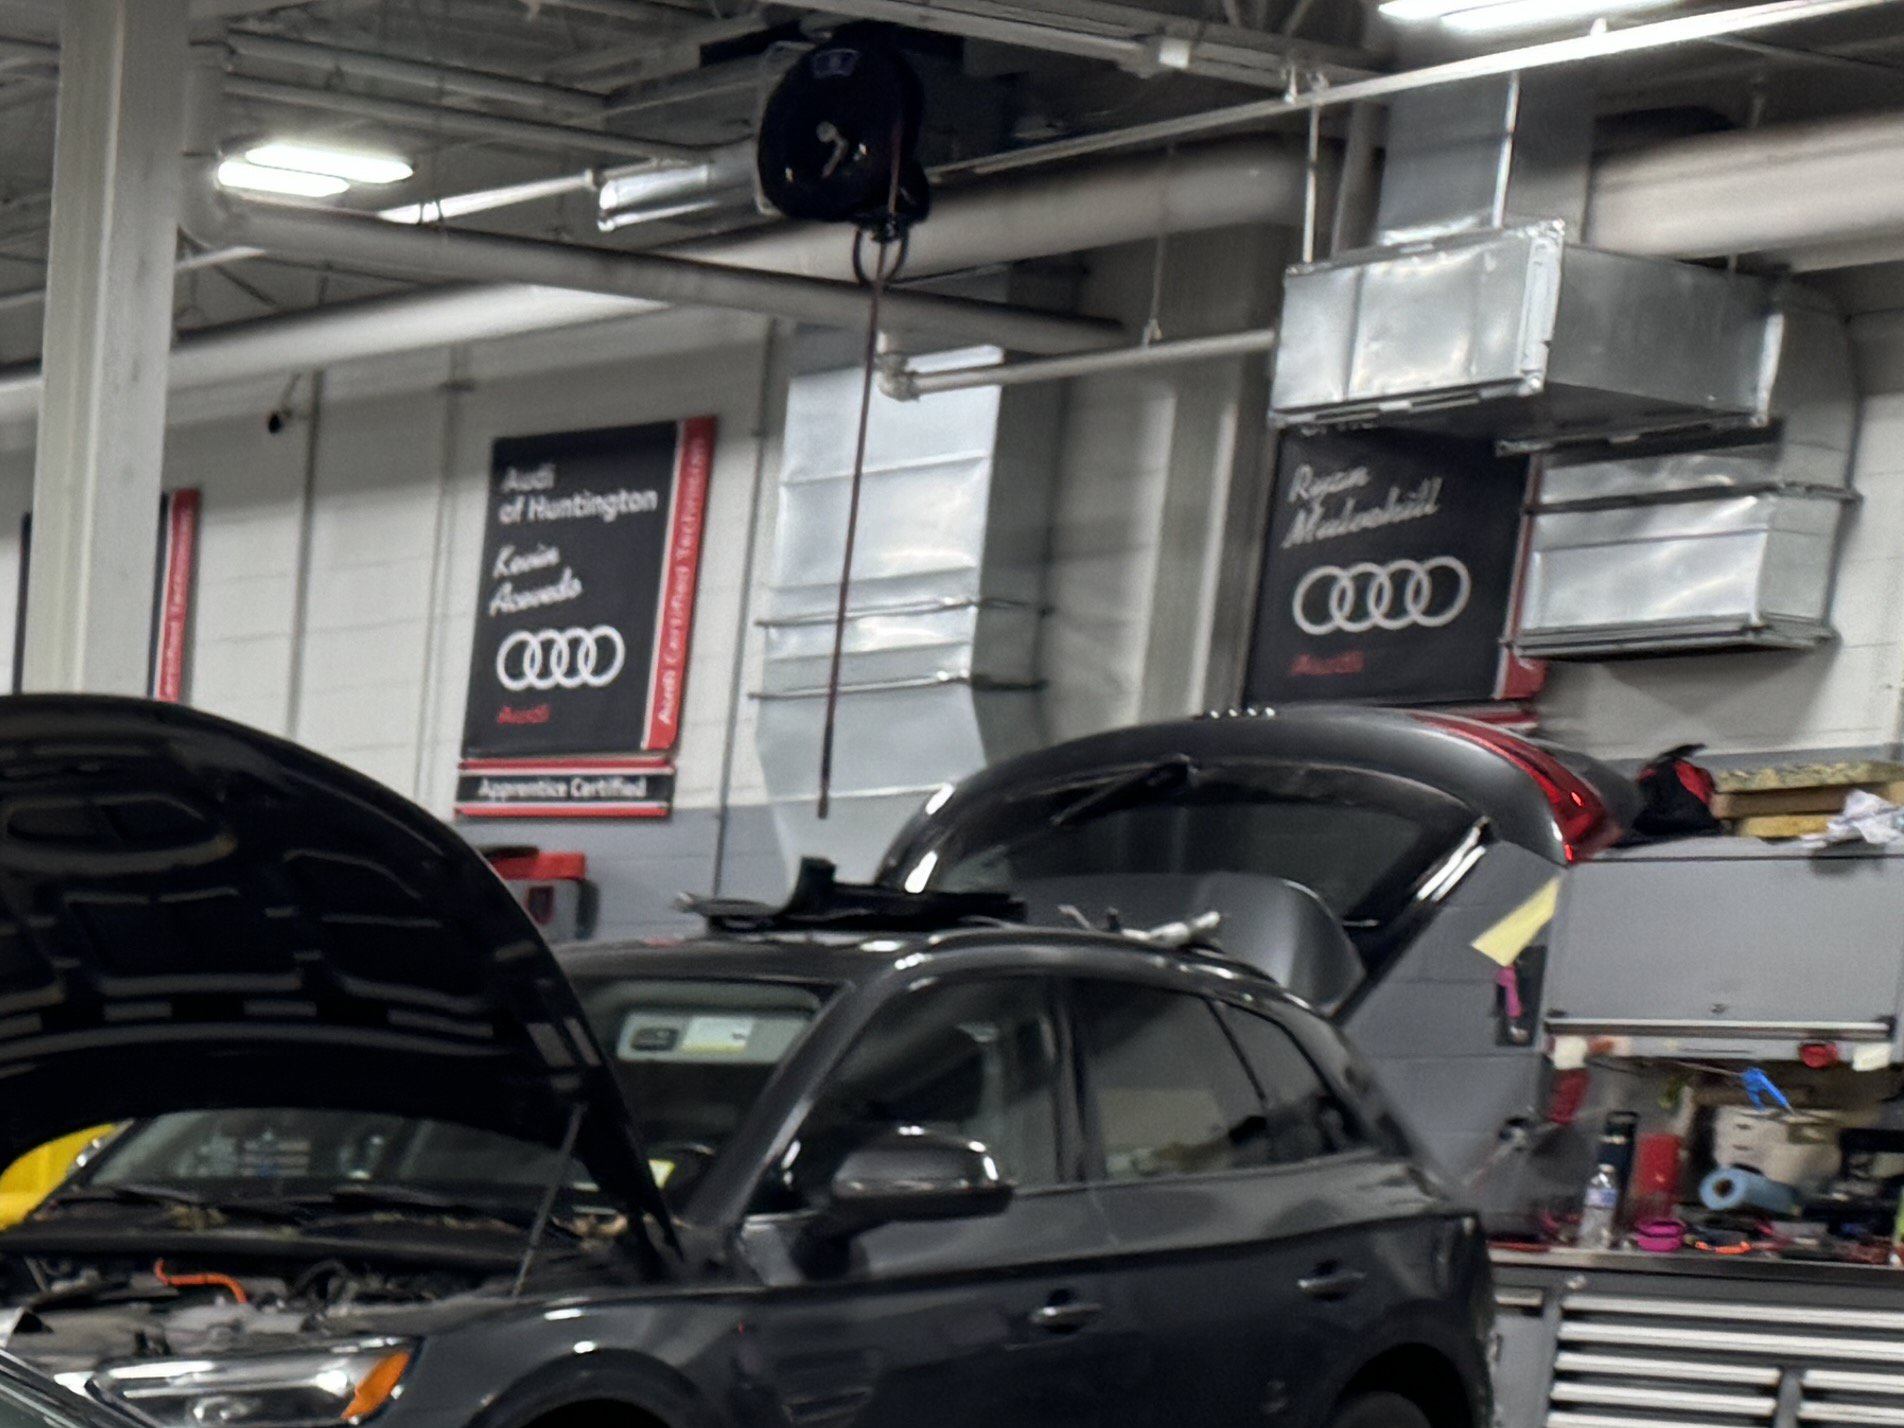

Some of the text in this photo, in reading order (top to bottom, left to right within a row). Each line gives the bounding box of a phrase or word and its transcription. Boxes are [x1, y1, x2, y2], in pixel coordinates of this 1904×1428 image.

[501, 463, 556, 493] Audi
[498, 488, 659, 525] of Huntington
[497, 703, 551, 726] Audi
[478, 775, 648, 802] Apprentice Certified
